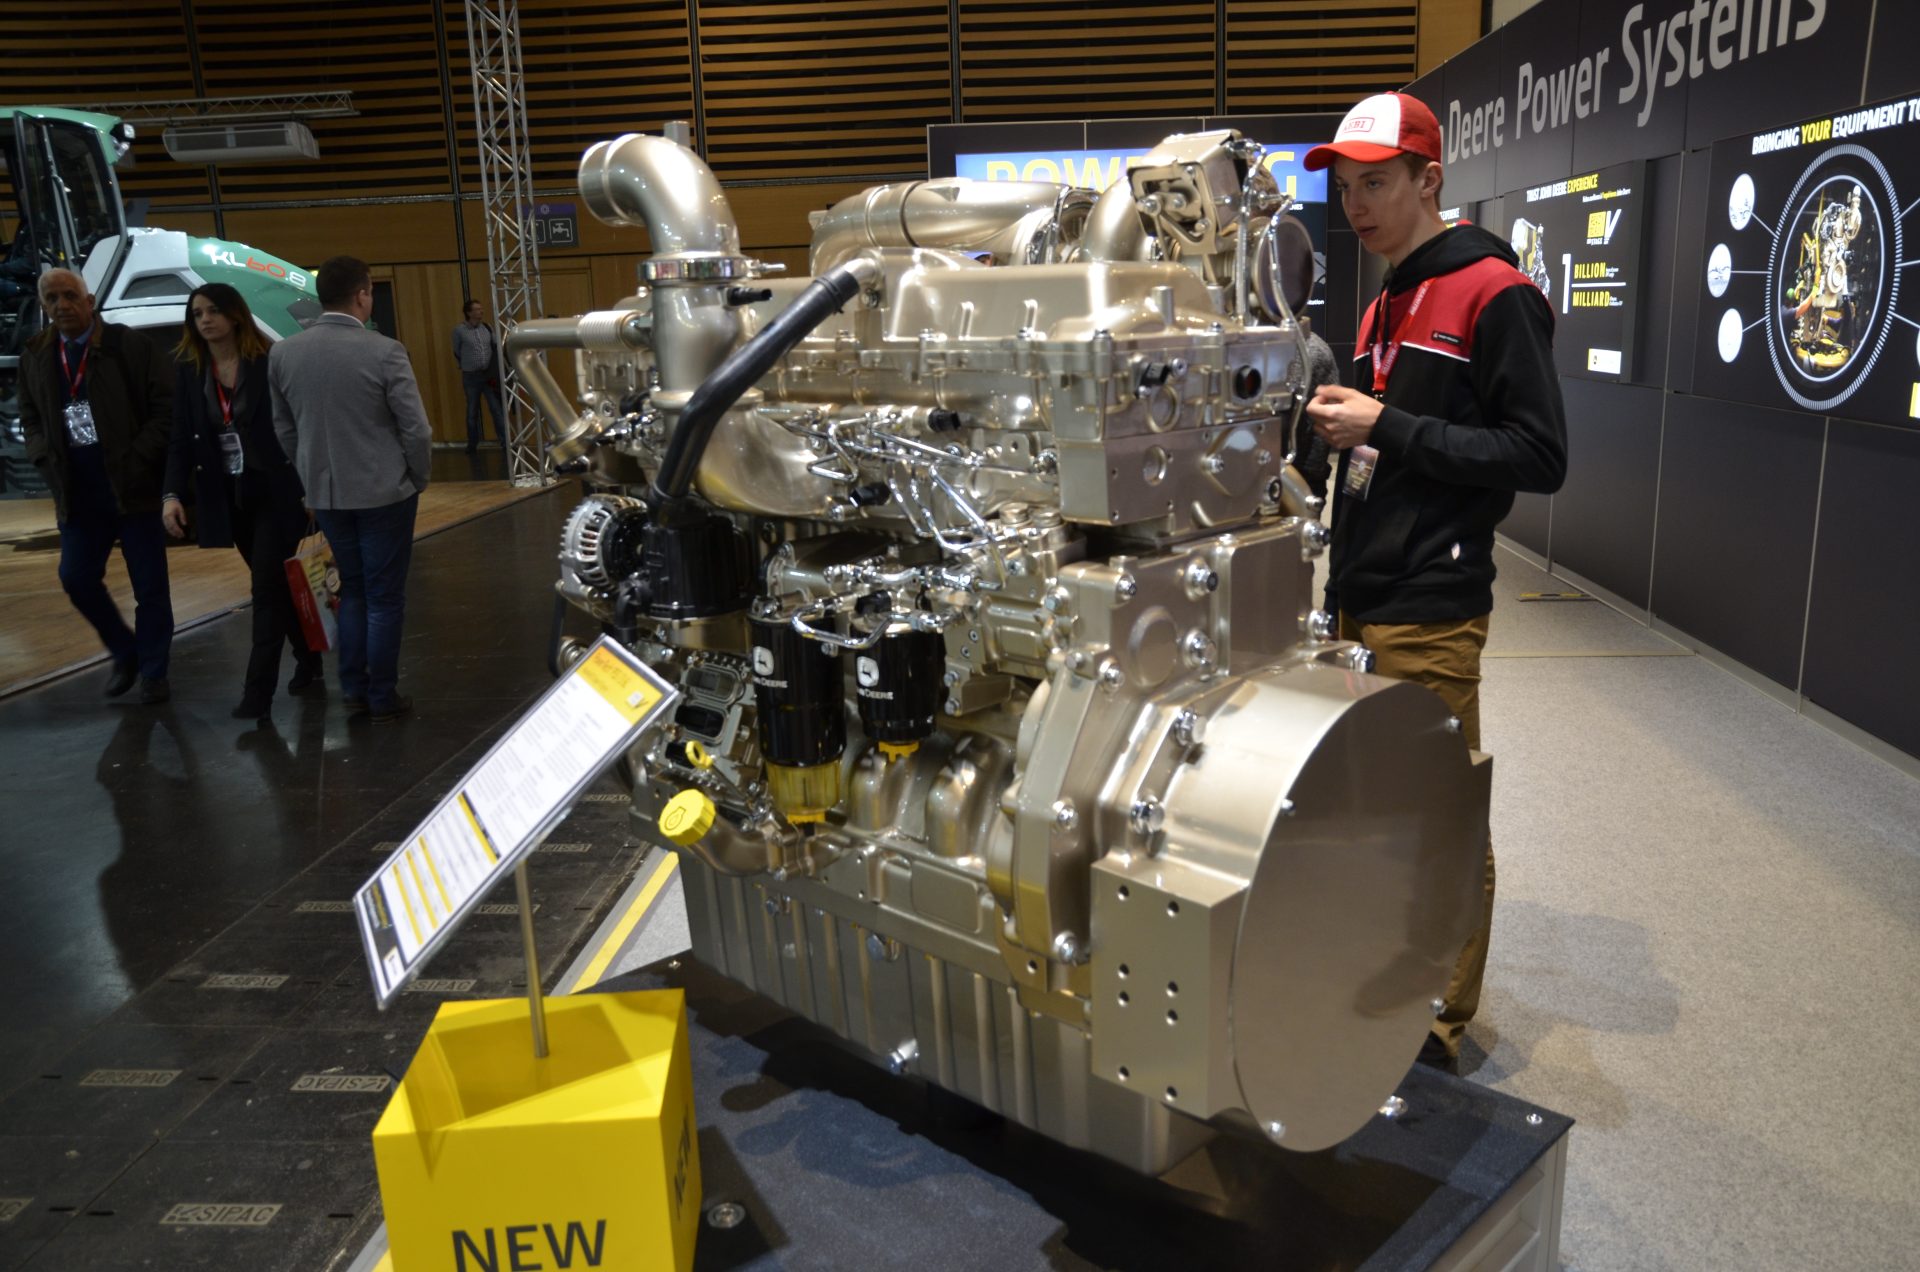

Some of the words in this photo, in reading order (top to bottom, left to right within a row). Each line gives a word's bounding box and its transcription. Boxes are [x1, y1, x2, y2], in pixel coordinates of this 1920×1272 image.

[1447, 94, 1505, 165] Deere
[1516, 47, 1609, 139] Power
[1751, 127, 1800, 155] BRINGING
[1801, 119, 1832, 144] YOUR
[1832, 101, 1907, 138] EQUIPMENT
[1567, 173, 1599, 194] EXPERIENCE
[1574, 261, 1606, 279] BILLION
[1562, 253, 1572, 315] 1
[1572, 290, 1610, 307] MILLIARD
[298, 1077, 362, 1089] SIPAC
[196, 1205, 275, 1223] SIPAC
[451, 1219, 607, 1272] NEW
